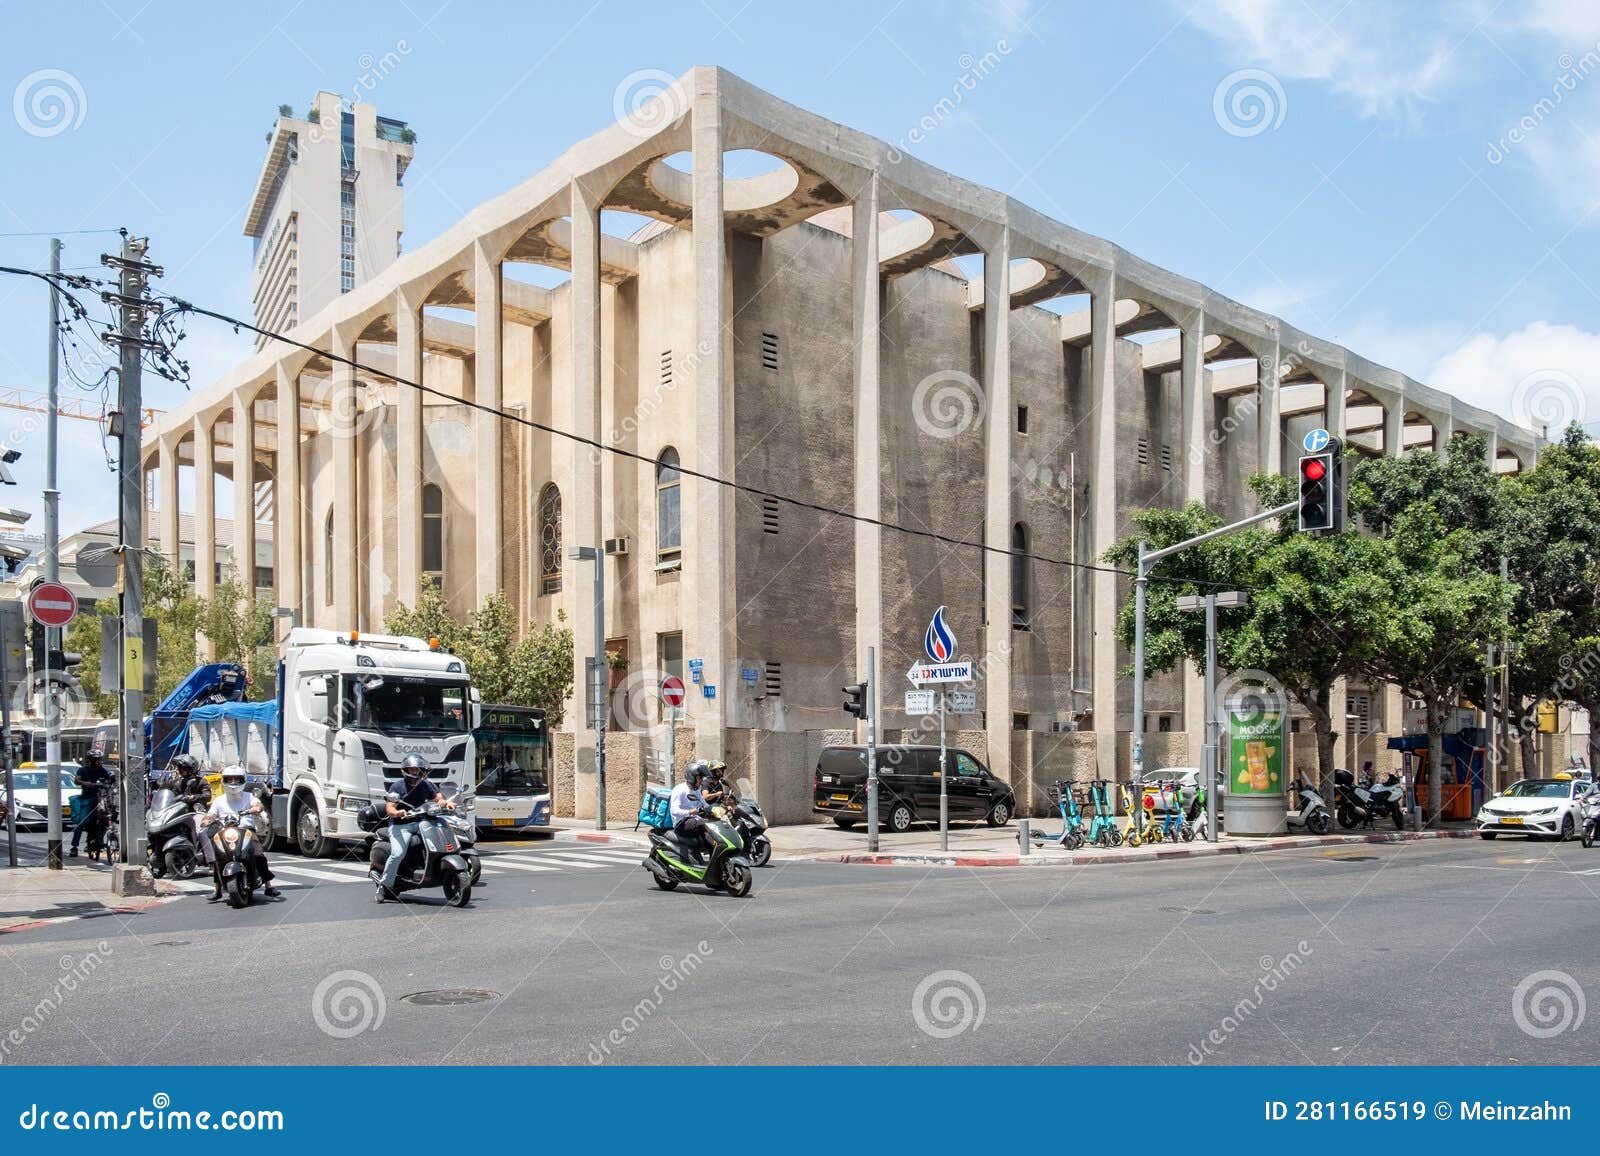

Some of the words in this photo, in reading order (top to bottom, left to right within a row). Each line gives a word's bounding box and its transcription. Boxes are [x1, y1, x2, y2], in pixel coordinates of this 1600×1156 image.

[131, 649, 138, 660] 3
[921, 667, 968, 680] אמישראגז
[393, 744, 441, 754] SCANIA
